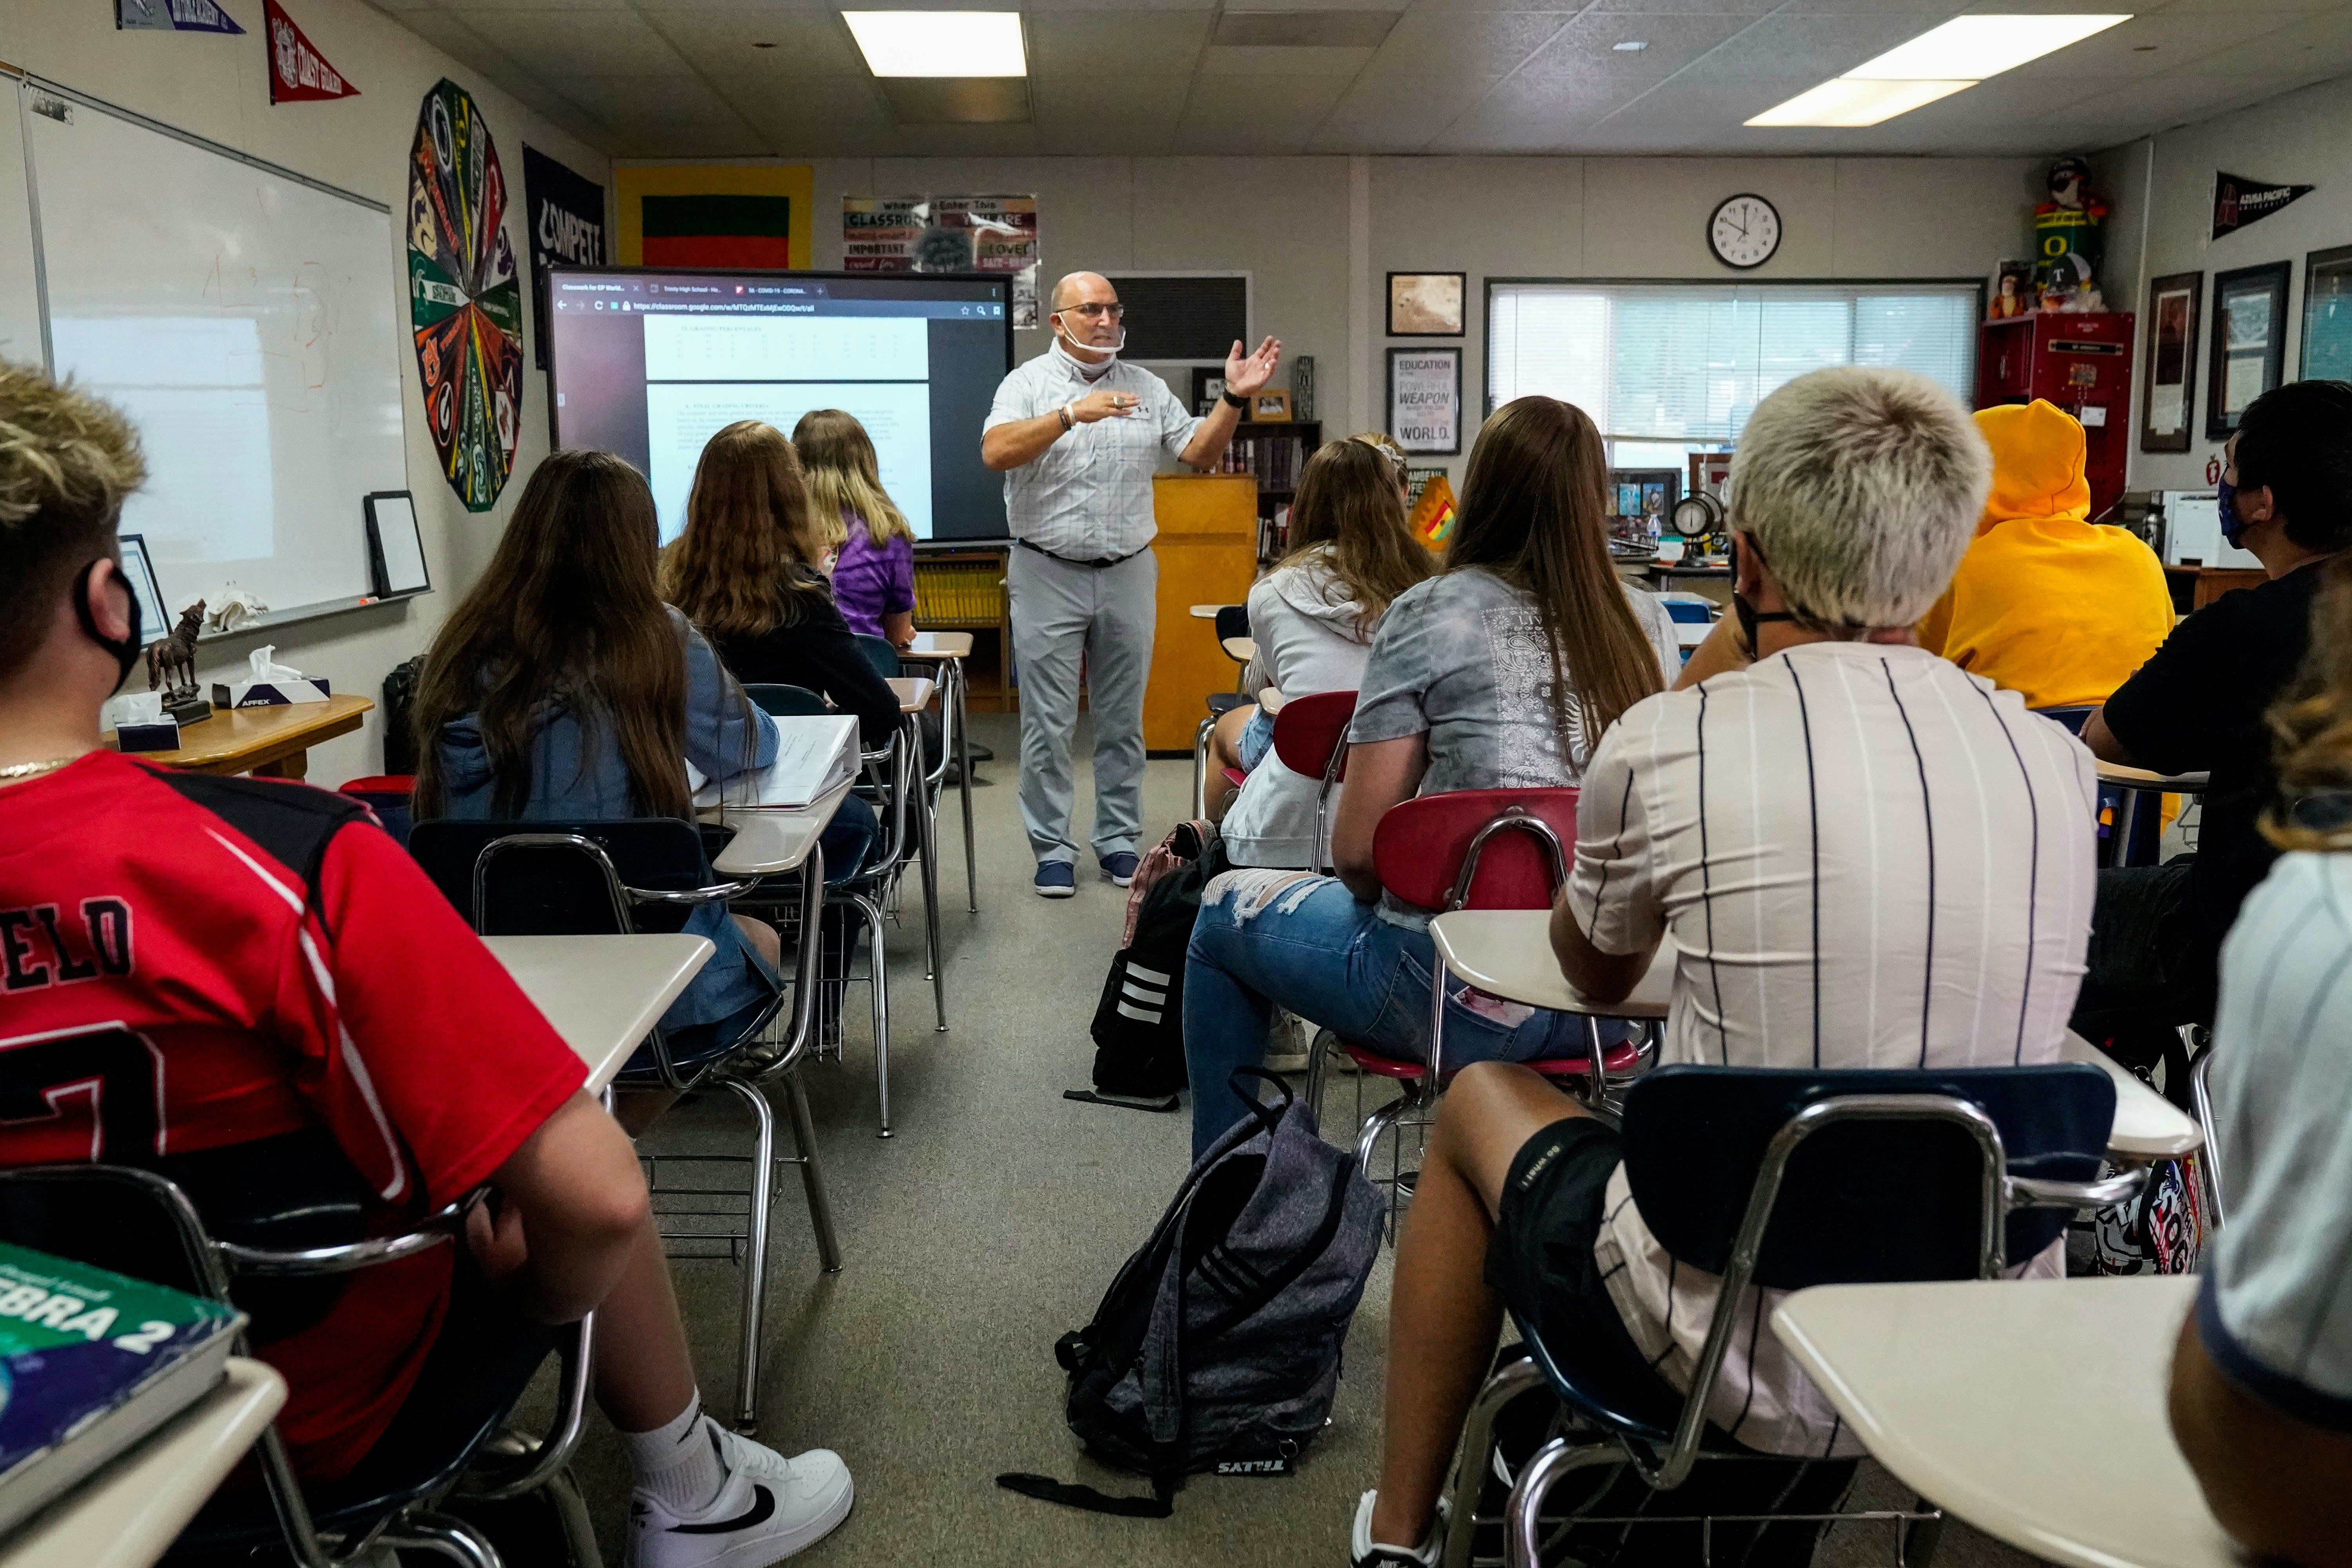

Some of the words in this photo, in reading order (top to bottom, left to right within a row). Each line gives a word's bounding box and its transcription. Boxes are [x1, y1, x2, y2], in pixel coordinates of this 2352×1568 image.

[849, 214, 934, 226] CLASSROM
[1399, 360, 1450, 370] EDUCATION
[1399, 392, 1449, 404] WEAPON
[113, 1320, 176, 1356] 2
